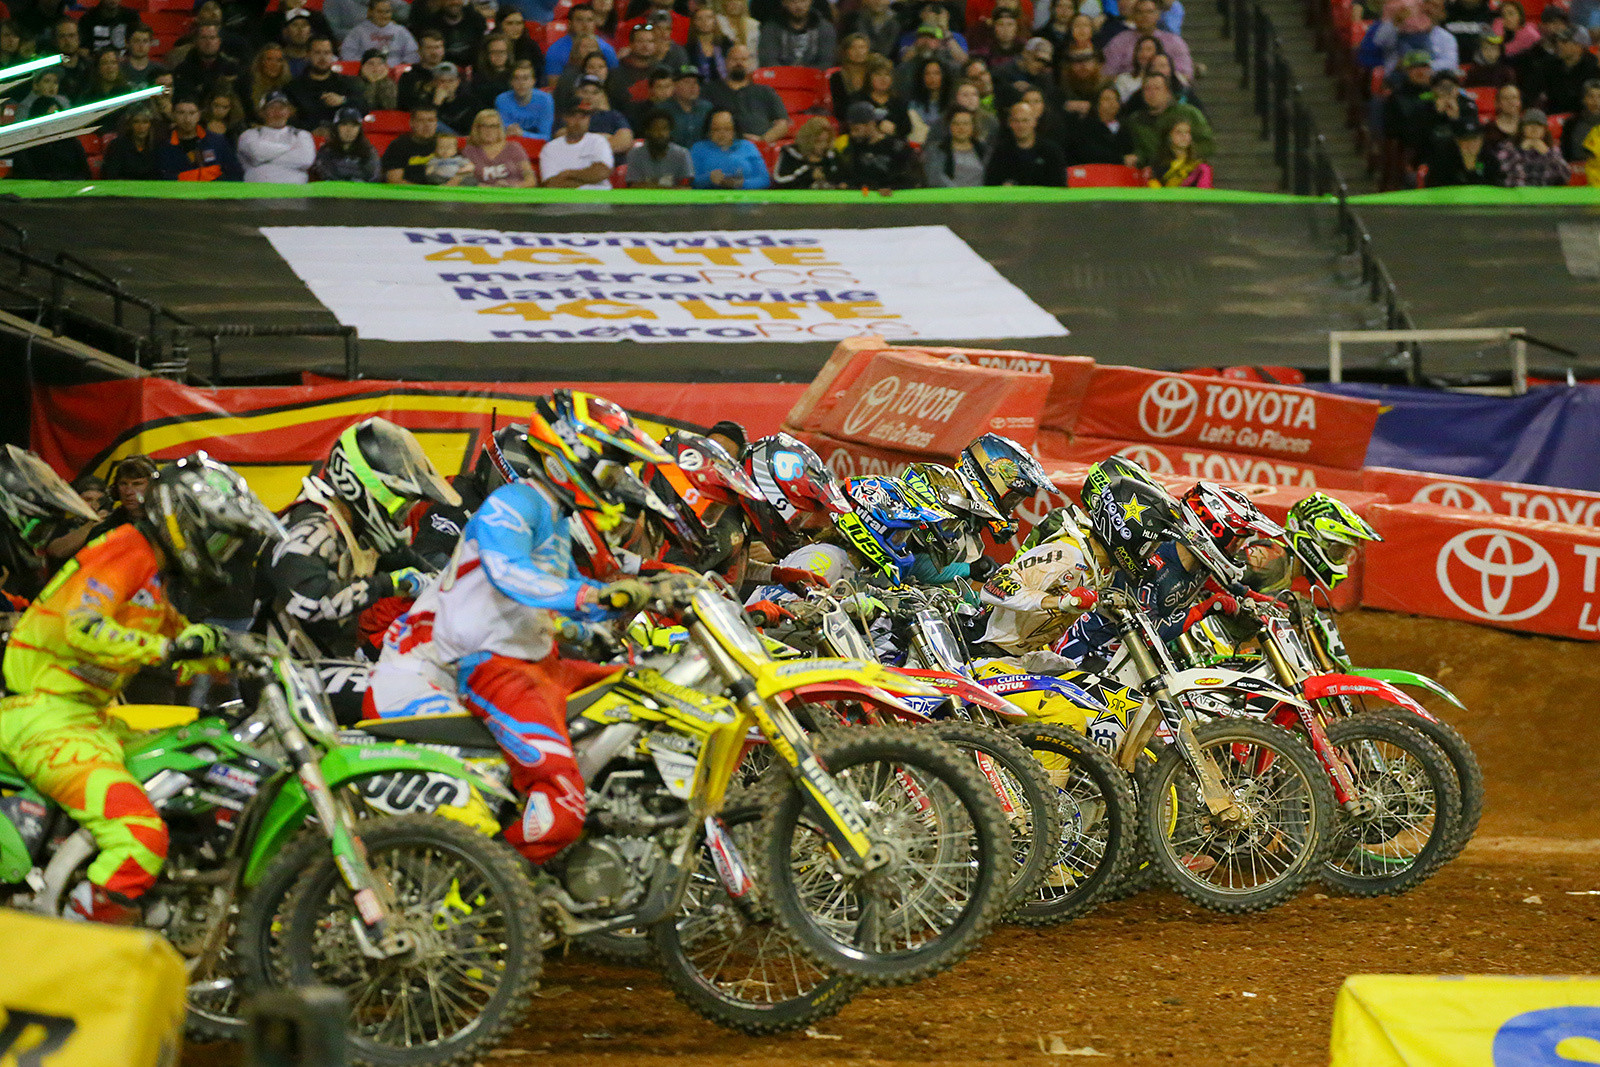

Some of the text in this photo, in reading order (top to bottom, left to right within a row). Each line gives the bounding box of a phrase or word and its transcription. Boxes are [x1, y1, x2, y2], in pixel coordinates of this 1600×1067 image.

[404, 232, 820, 247] Nationwide
[424, 246, 842, 266] 4G LTE
[454, 287, 878, 301] Nationwide
[476, 299, 902, 321] 4G LTE
[889, 381, 967, 423] TOYOTA
[1205, 385, 1317, 430] TOYOTA
[1236, 427, 1260, 447] Go
[1182, 453, 1317, 488] TOYOTA
[856, 506, 887, 534] viral
[1035, 735, 1081, 754] DUNLOP
